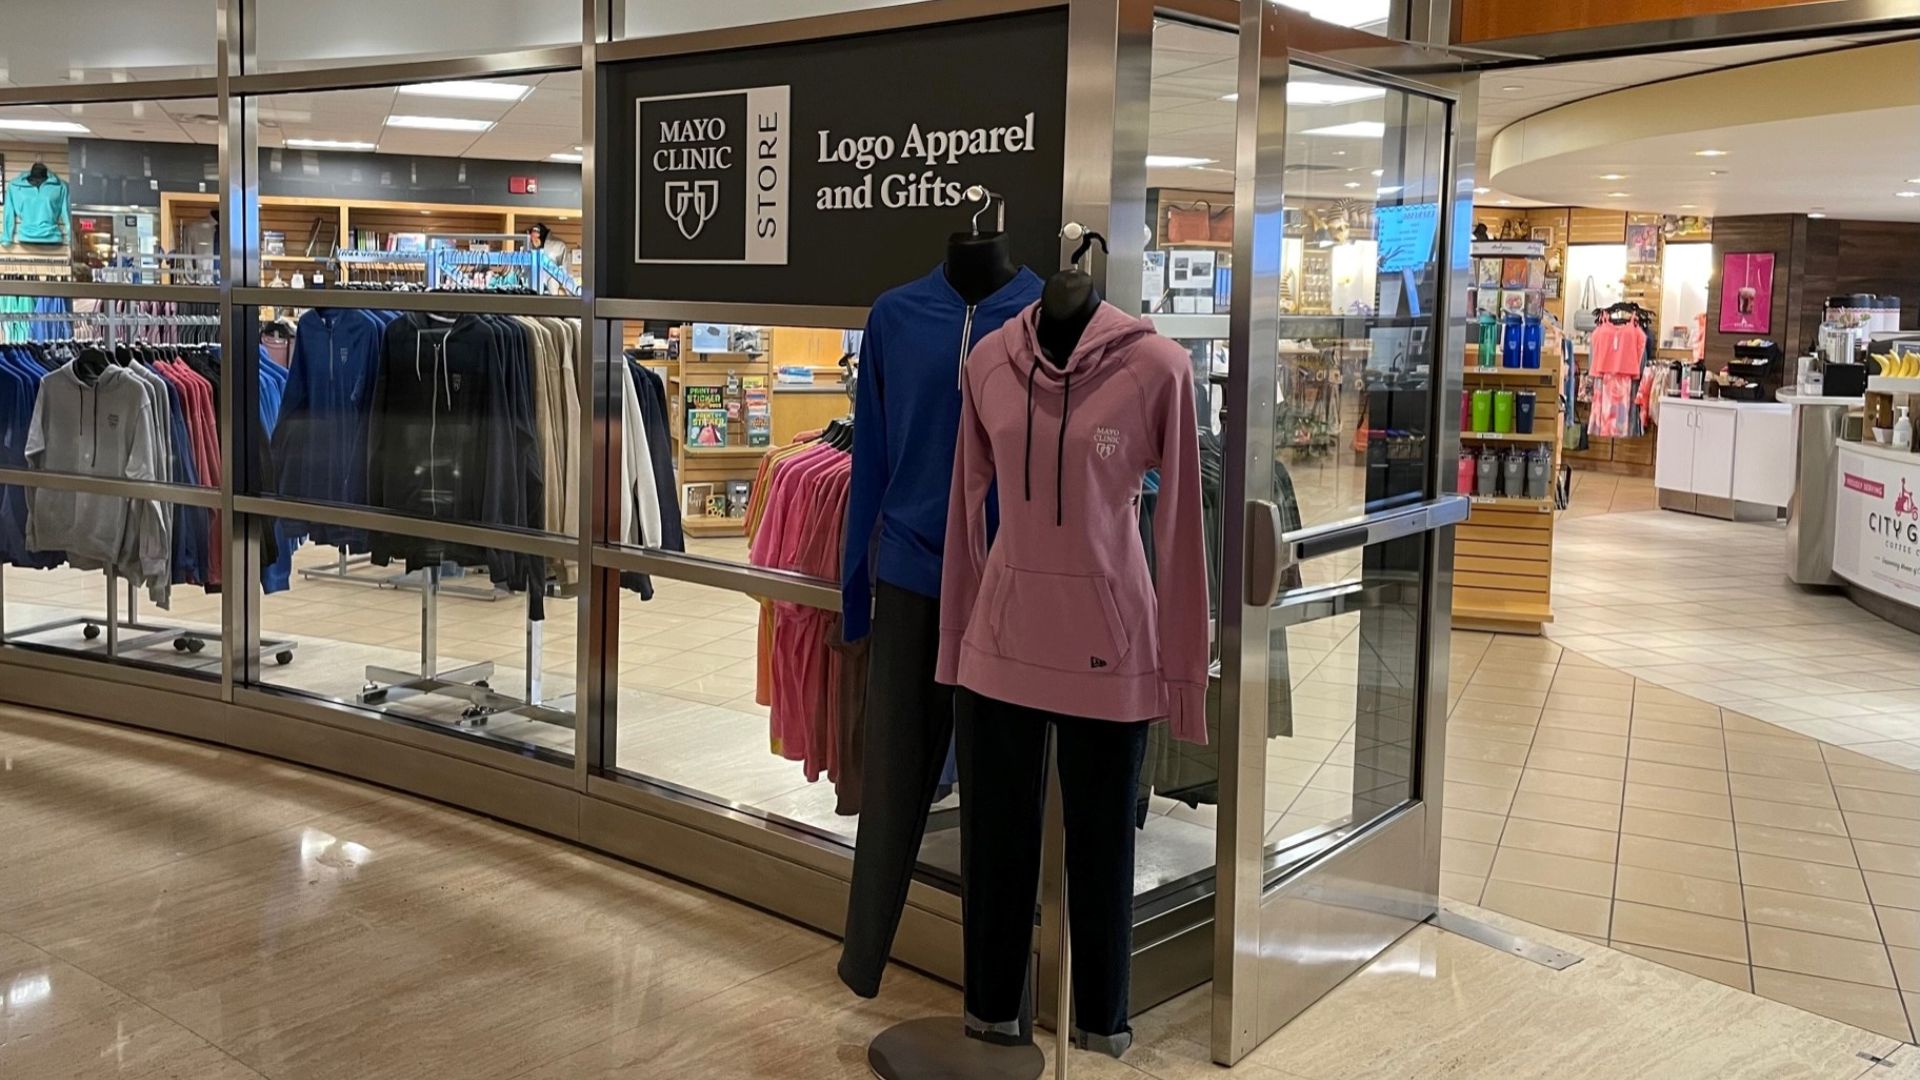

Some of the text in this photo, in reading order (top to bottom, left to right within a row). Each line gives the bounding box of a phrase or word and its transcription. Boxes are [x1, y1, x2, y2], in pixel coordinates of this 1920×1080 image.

[660, 117, 726, 143] MAYO
[818, 112, 1035, 170] Logo Apparel
[653, 146, 732, 171] CLINIC
[758, 112, 777, 238] STORE
[816, 170, 961, 210] and Gifts
[1094, 434, 1120, 444] CLINIC
[1096, 427, 1120, 436] MAYO
[1869, 512, 1902, 540] CITY
